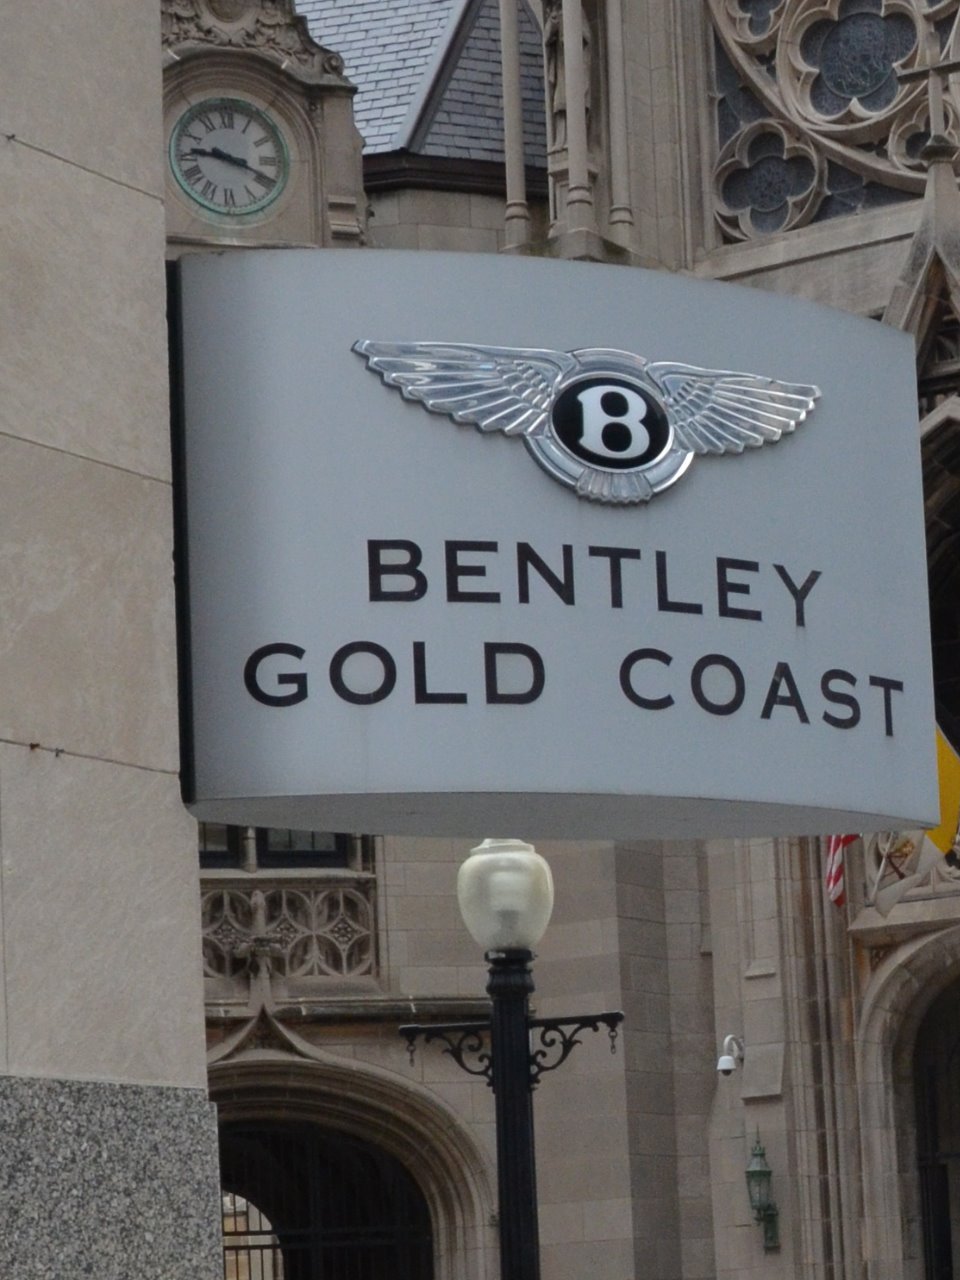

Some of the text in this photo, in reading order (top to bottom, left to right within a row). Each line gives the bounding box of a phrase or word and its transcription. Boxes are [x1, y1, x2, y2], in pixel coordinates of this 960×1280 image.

[578, 383, 650, 460] B
[365, 538, 822, 628] BENTLEY
[243, 640, 905, 738] GOLD COAST
